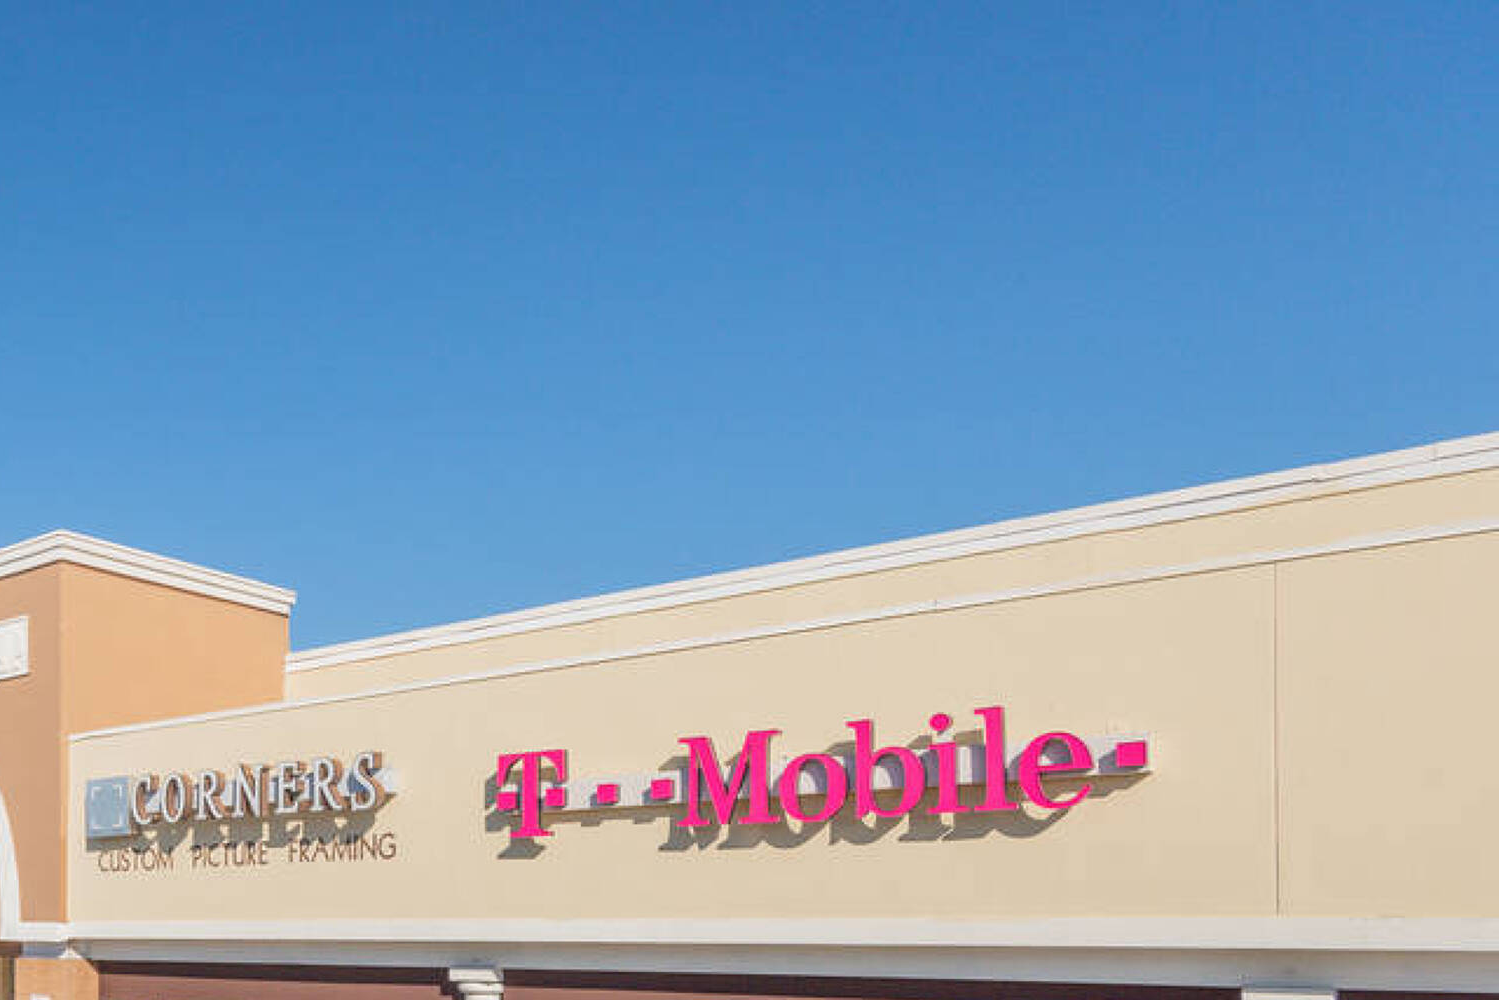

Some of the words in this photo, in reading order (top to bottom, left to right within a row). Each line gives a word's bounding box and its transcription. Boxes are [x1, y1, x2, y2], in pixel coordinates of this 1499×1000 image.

[133, 752, 382, 826] CORNERS
[98, 845, 175, 872] CUSTOM
[191, 840, 269, 868] PICTURE
[288, 831, 397, 864] FRAMING
